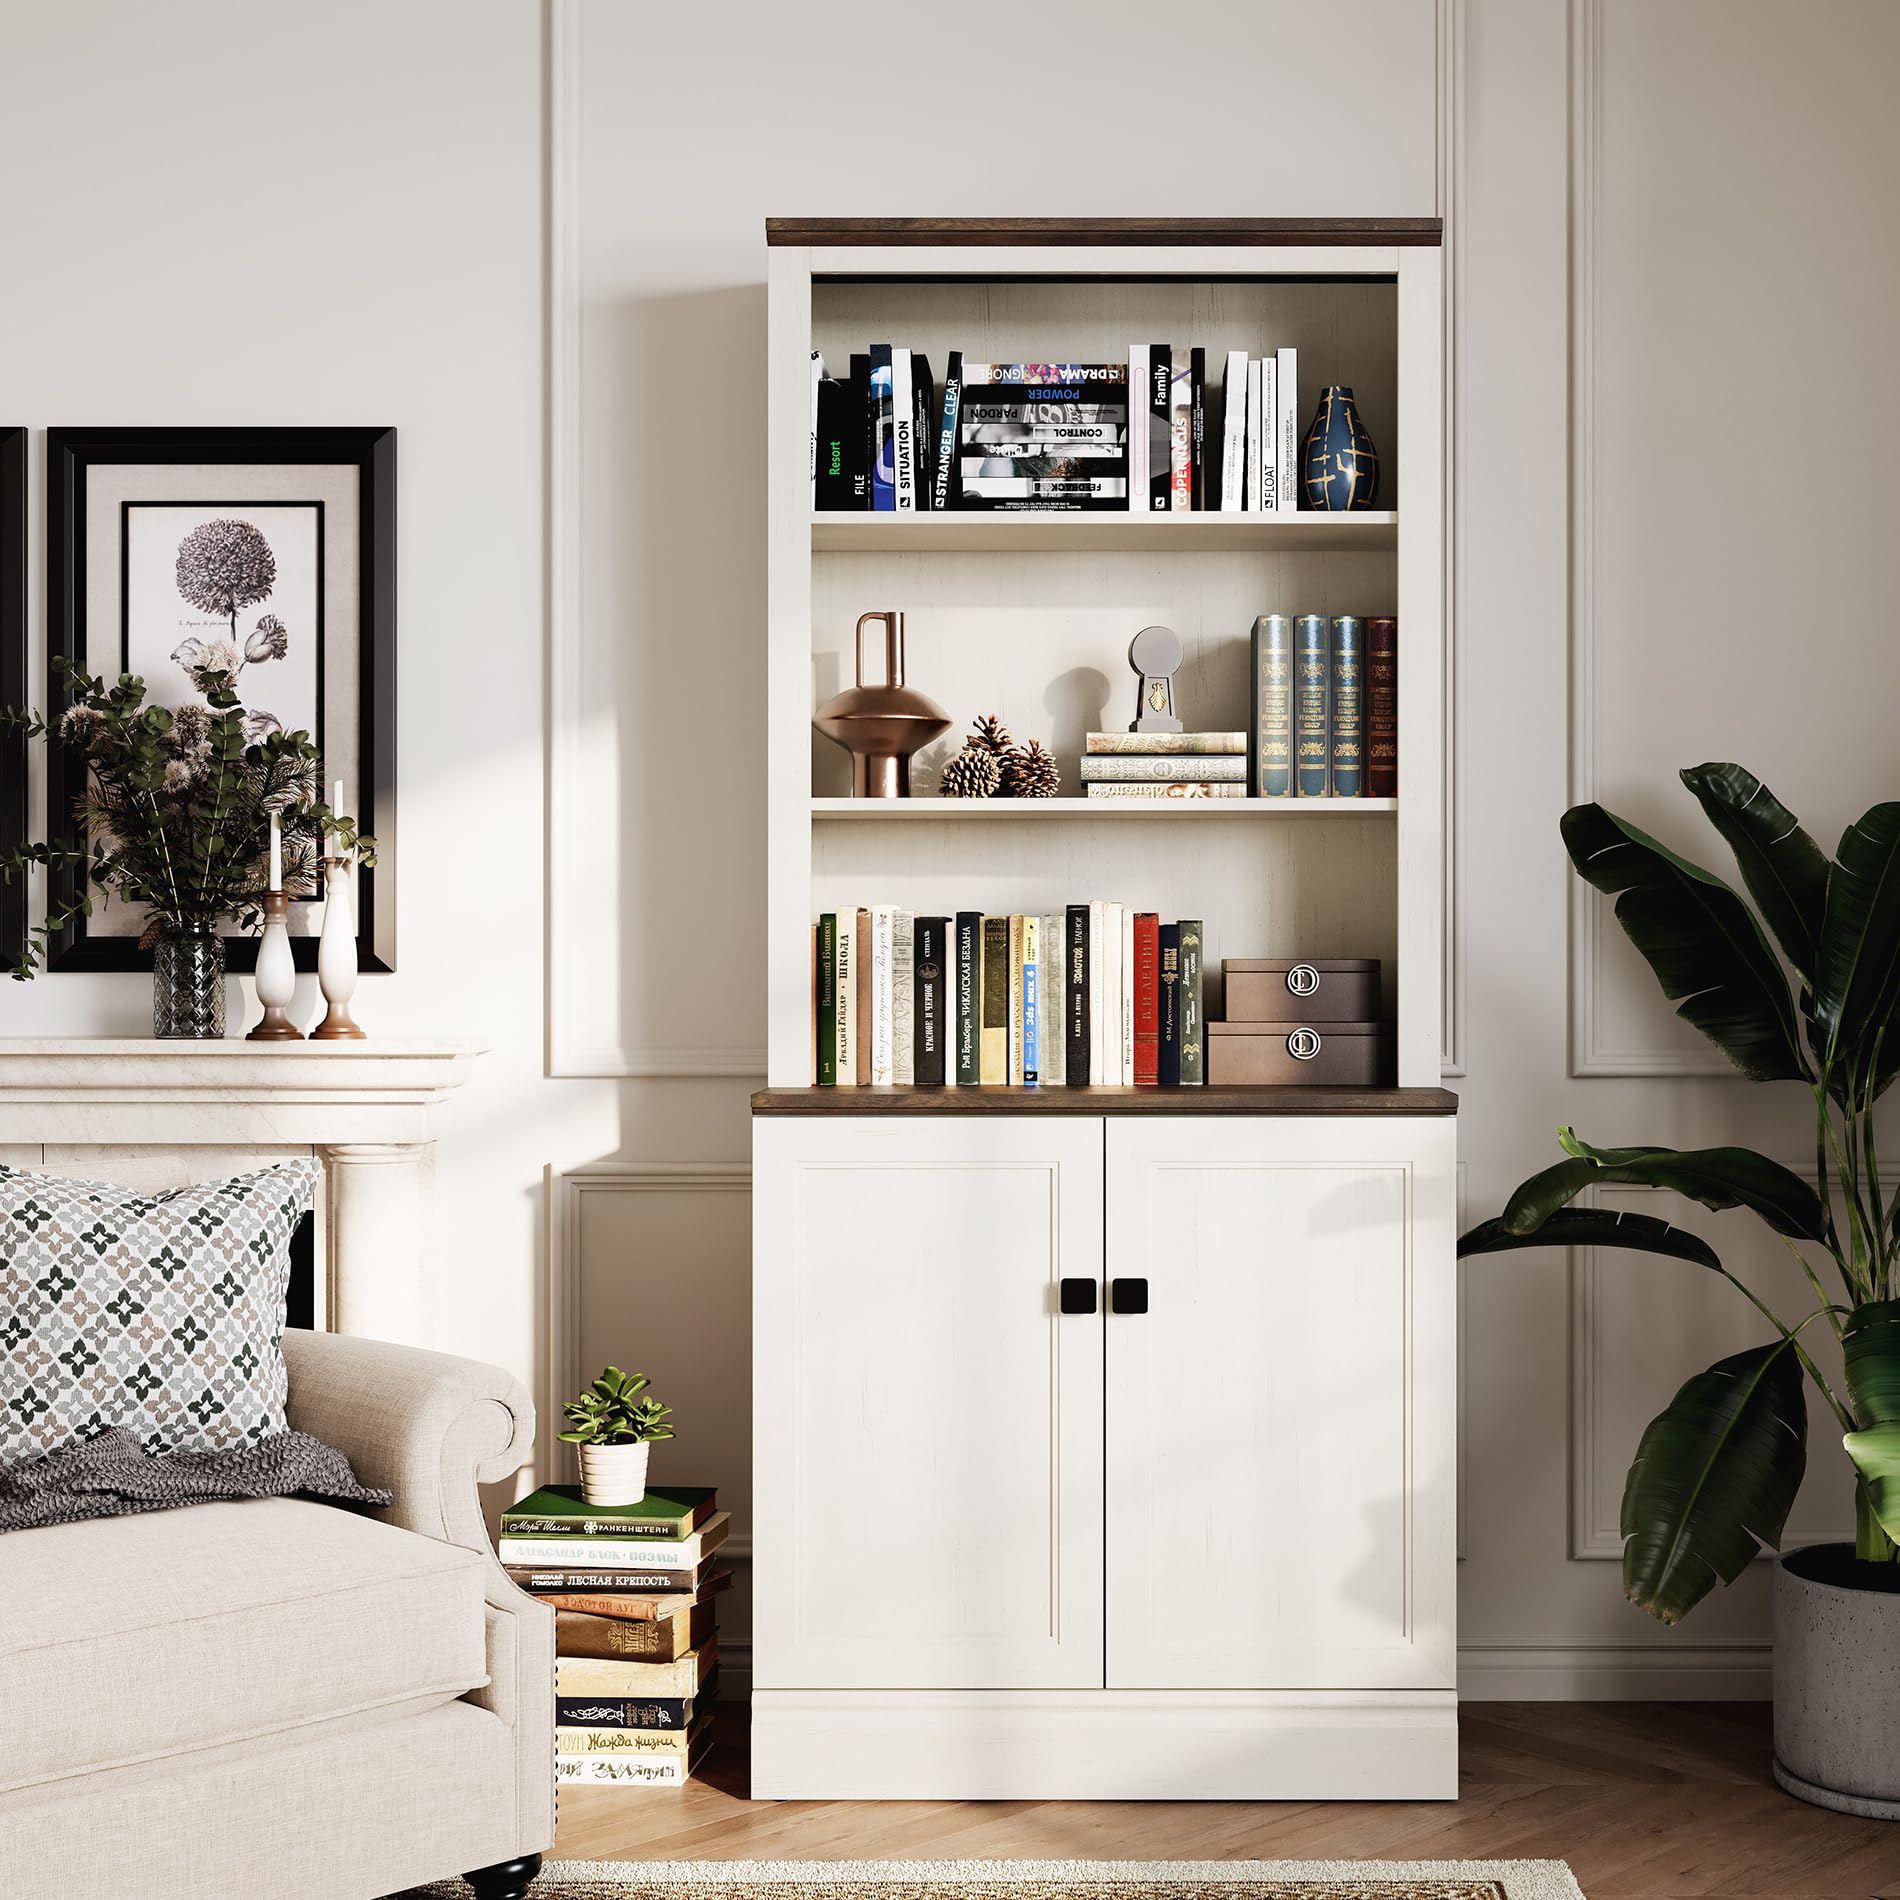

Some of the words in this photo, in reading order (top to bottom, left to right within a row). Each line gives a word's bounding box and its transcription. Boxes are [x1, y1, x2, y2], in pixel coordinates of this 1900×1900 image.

[981, 368, 1025, 380] IGNORE
[1059, 368, 1107, 380] DRAMA
[1154, 364, 1169, 406] Family
[1028, 388, 1080, 400] POWDER
[970, 408, 1018, 419] PARDON
[935, 430, 953, 496] STRANGER
[944, 379, 959, 416] CLEAR
[1054, 428, 1103, 438] CONTROL
[829, 441, 841, 476] Resort
[898, 420, 910, 489] SITUATION
[1176, 417, 1187, 506] COPERNICUS
[854, 474, 865, 495] FILE
[1051, 482, 1102, 492] FEEDBACK
[1264, 464, 1275, 498] FLOAT
[822, 922, 832, 959] Бианки
[961, 926, 971, 961] БЕЗДНА
[1074, 916, 1083, 944] ТЕЛЕНОК
[839, 934, 850, 979] ШКОЛА
[822, 961, 833, 1007] Виталий
[1026, 970, 1035, 979] 4
[924, 983, 933, 1012] ЧЕРНОЕ
[961, 962, 971, 1016] ЧИКАГСКАЯ
[1027, 984, 1035, 1004] max
[1026, 1007, 1035, 1026] 3ds
[925, 1020, 934, 1053] КРАСНОЕ
[962, 1018, 972, 1055] Брэдбери
[962, 1055, 971, 1069] Рэй
[514, 1545, 585, 1559] АЛЕКСАНДР
[588, 1550, 622, 1561] БЛОК
[629, 1552, 680, 1564] ПОЭМЫ
[566, 1575, 612, 1586] ЛЕСНАЯ
[615, 1575, 671, 1586] КРЕПОСТЬ
[559, 1733, 584, 1751] ТОУН
[587, 1732, 633, 1750] Жажда
[634, 1735, 677, 1750] жизни
